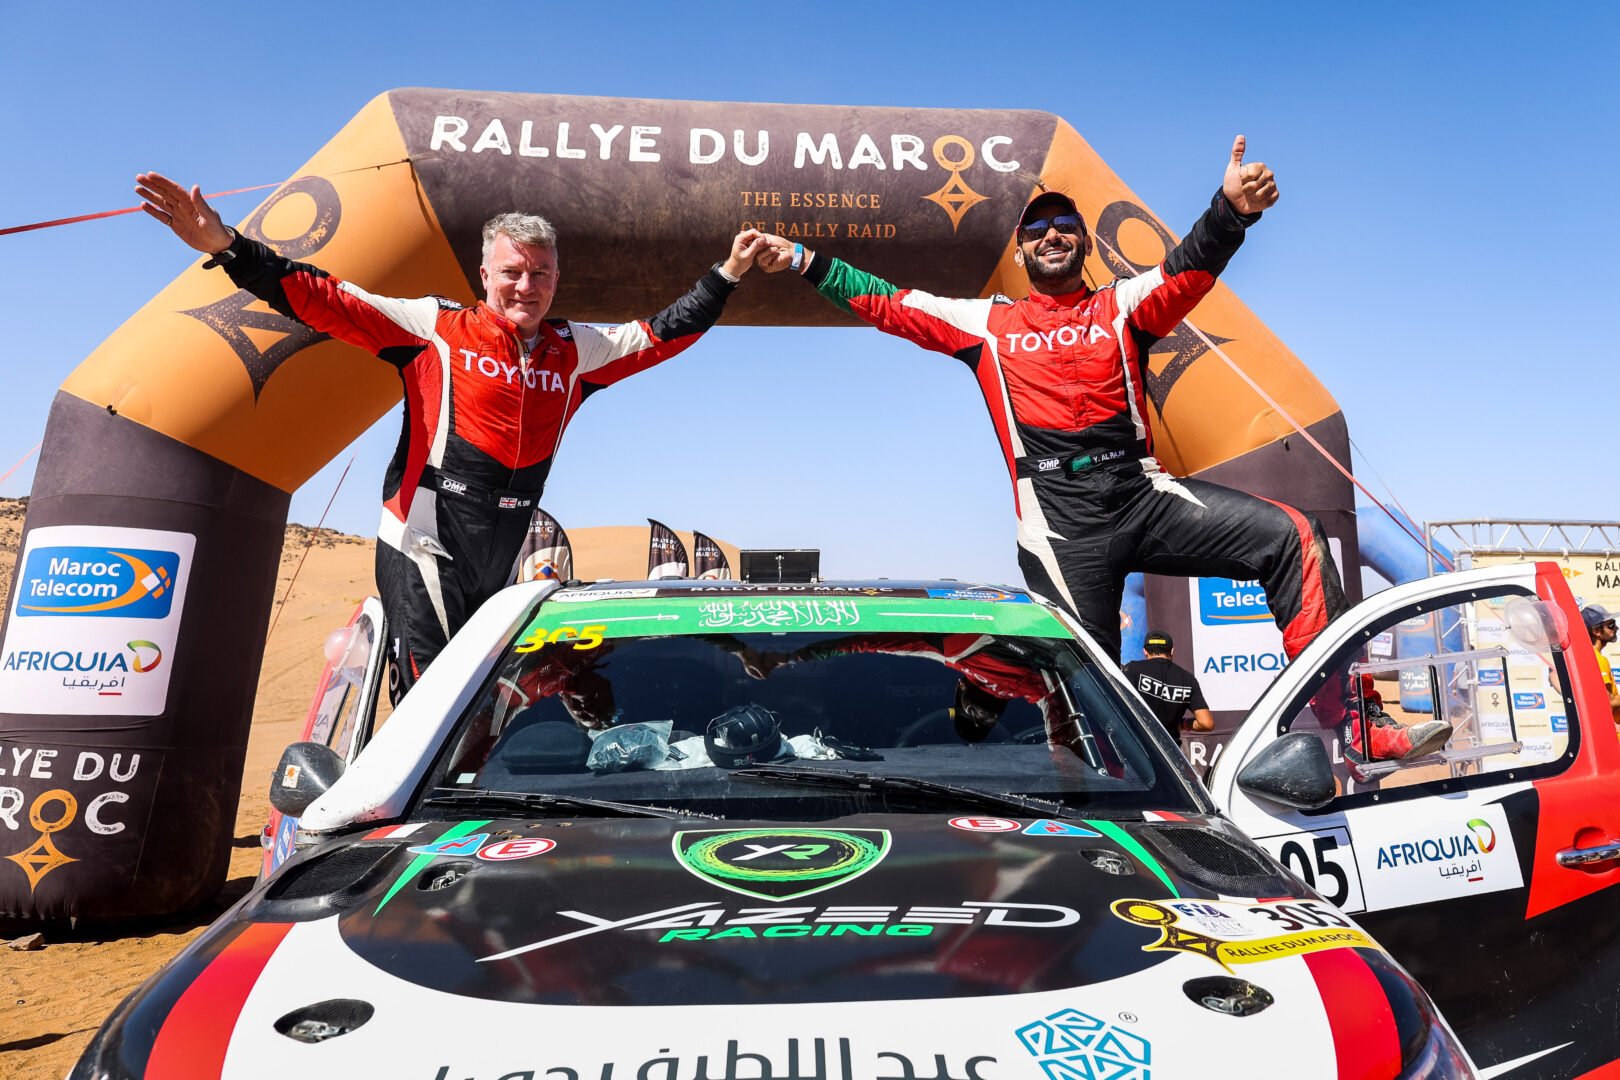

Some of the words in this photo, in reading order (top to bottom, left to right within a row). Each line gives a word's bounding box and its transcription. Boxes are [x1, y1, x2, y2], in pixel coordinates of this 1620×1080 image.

[430, 115, 662, 163] RALLYE
[689, 127, 770, 166] DU
[793, 132, 1021, 172] MAROC
[741, 191, 782, 207] THE
[790, 192, 881, 209] ESSENCE
[775, 222, 839, 238] RALLY
[848, 223, 897, 239] RAID
[1005, 324, 1112, 353] TOYOTA
[459, 348, 565, 394] TOYOTA
[1038, 459, 1060, 470] OMP
[442, 479, 468, 494] OMP
[49, 557, 121, 577] Maroc
[30, 579, 118, 598] Telecom
[559, 589, 634, 598] AFRIQUIA
[3, 651, 128, 672] AFRIQUIA
[1140, 677, 1192, 701] STAFF
[0, 746, 59, 779] YE
[73, 751, 141, 782] DU
[1377, 834, 1479, 869] AFRIQUIA
[1263, 836, 1349, 908] 05
[1172, 903, 1231, 919] FIA
[1248, 902, 1351, 931] 305
[475, 901, 1080, 962] YAZEED
[658, 923, 934, 943] RACING
[1225, 943, 1280, 958] RALLYE
[1302, 933, 1362, 947] MAROC
